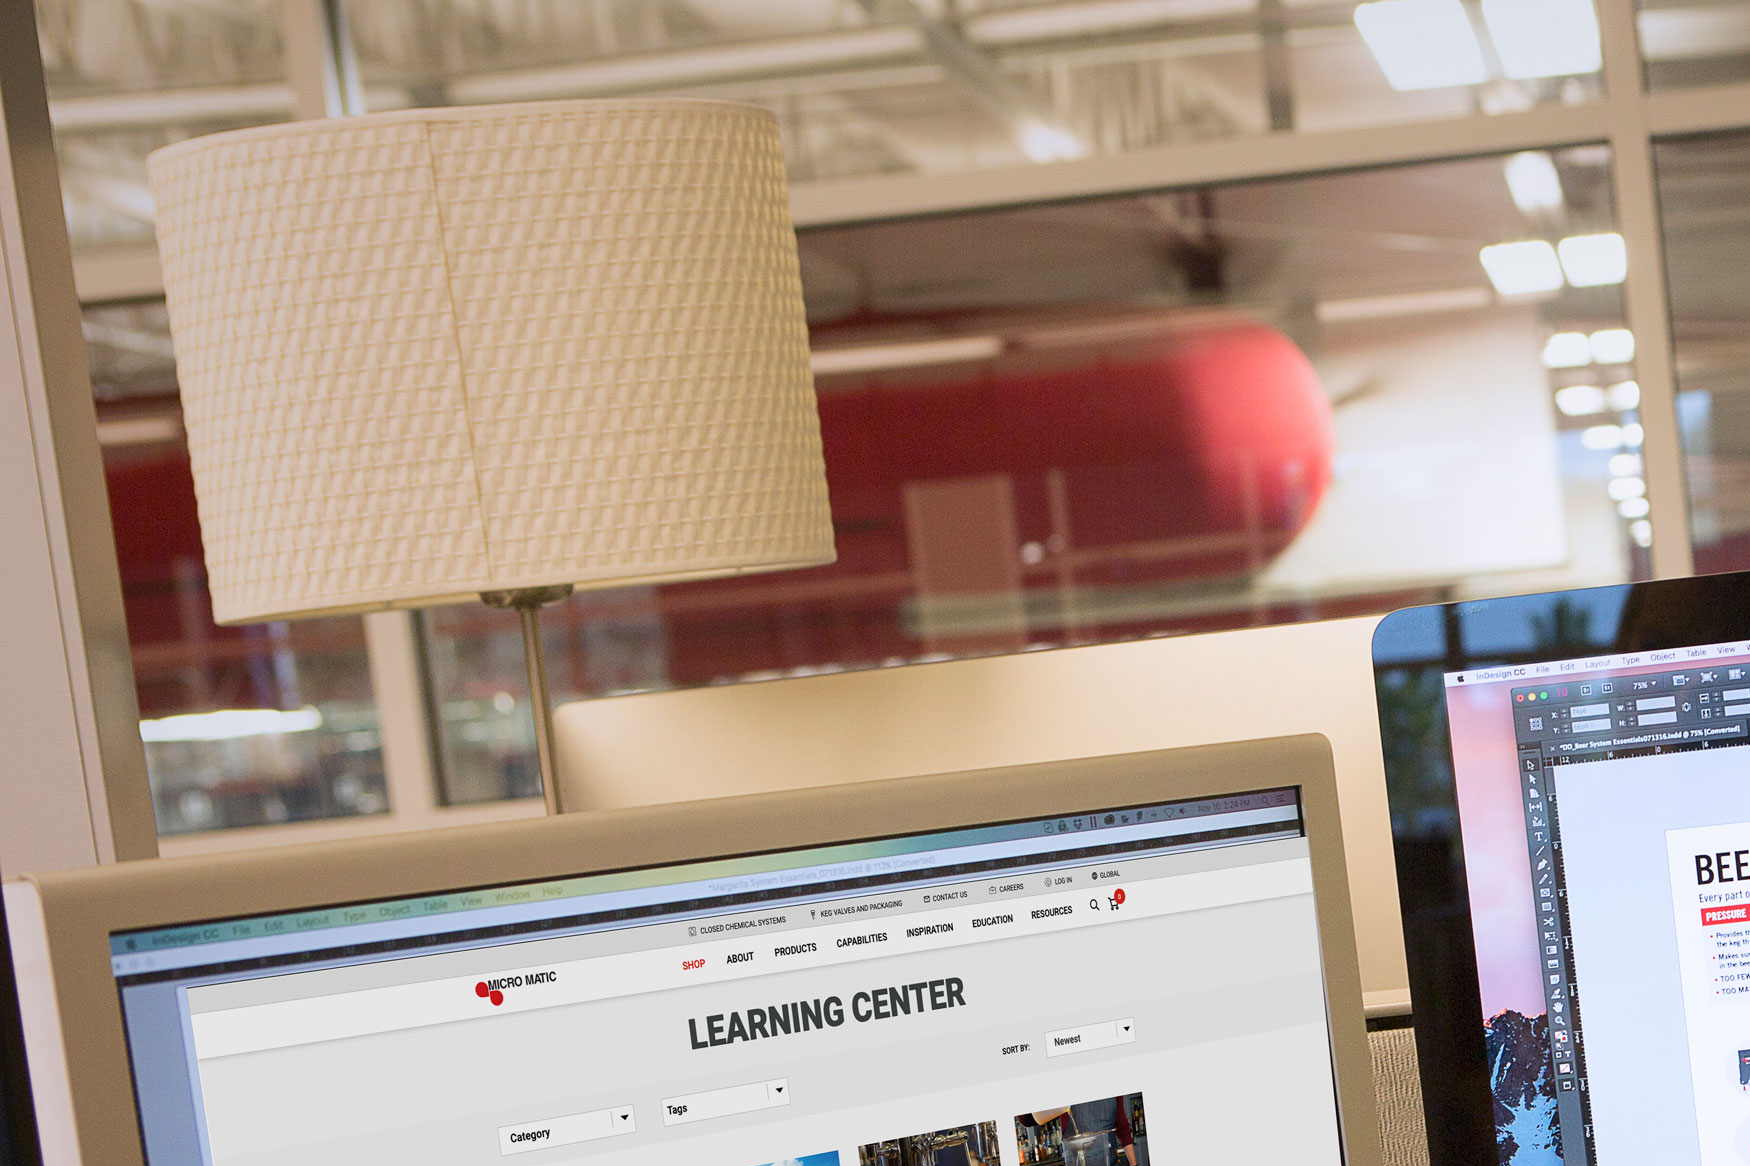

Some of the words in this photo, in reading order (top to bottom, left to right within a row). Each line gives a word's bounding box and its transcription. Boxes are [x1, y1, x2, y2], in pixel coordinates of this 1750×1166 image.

[1099, 870, 1120, 878] GLOBAL
[999, 883, 1024, 892] CAREERS
[1054, 877, 1065, 885] LOG
[932, 892, 958, 902] CONTACT
[959, 890, 967, 898] US
[1698, 893, 1722, 903] Every
[1725, 890, 1742, 902] part
[820, 909, 832, 917] KEG
[833, 906, 855, 915] VALVES
[856, 904, 868, 912] AND
[869, 900, 902, 910] PACKAGING
[1031, 905, 1072, 919] RESOURCES
[1706, 907, 1747, 921] PRESSURE
[700, 924, 724, 934] CLOSED
[725, 920, 757, 930] CHEMICAL
[757, 916, 786, 926] SYSTEMS
[972, 914, 1013, 927] EDUCATION
[906, 922, 953, 937] INSPIRATION
[836, 932, 887, 947] CAPABILITIES
[774, 942, 817, 956] PRODUCTS
[682, 958, 705, 970] SHOP
[726, 951, 753, 964] ABOUT
[488, 976, 522, 990] MICRO
[525, 971, 556, 985] MATIC
[688, 995, 844, 1050] LEARNING
[851, 977, 966, 1022] CENTER
[1054, 1034, 1081, 1046] Newest
[1002, 1045, 1018, 1055] SORT
[1019, 1043, 1030, 1052] BY:
[666, 1105, 687, 1116] Tags
[510, 1129, 550, 1143] Category
